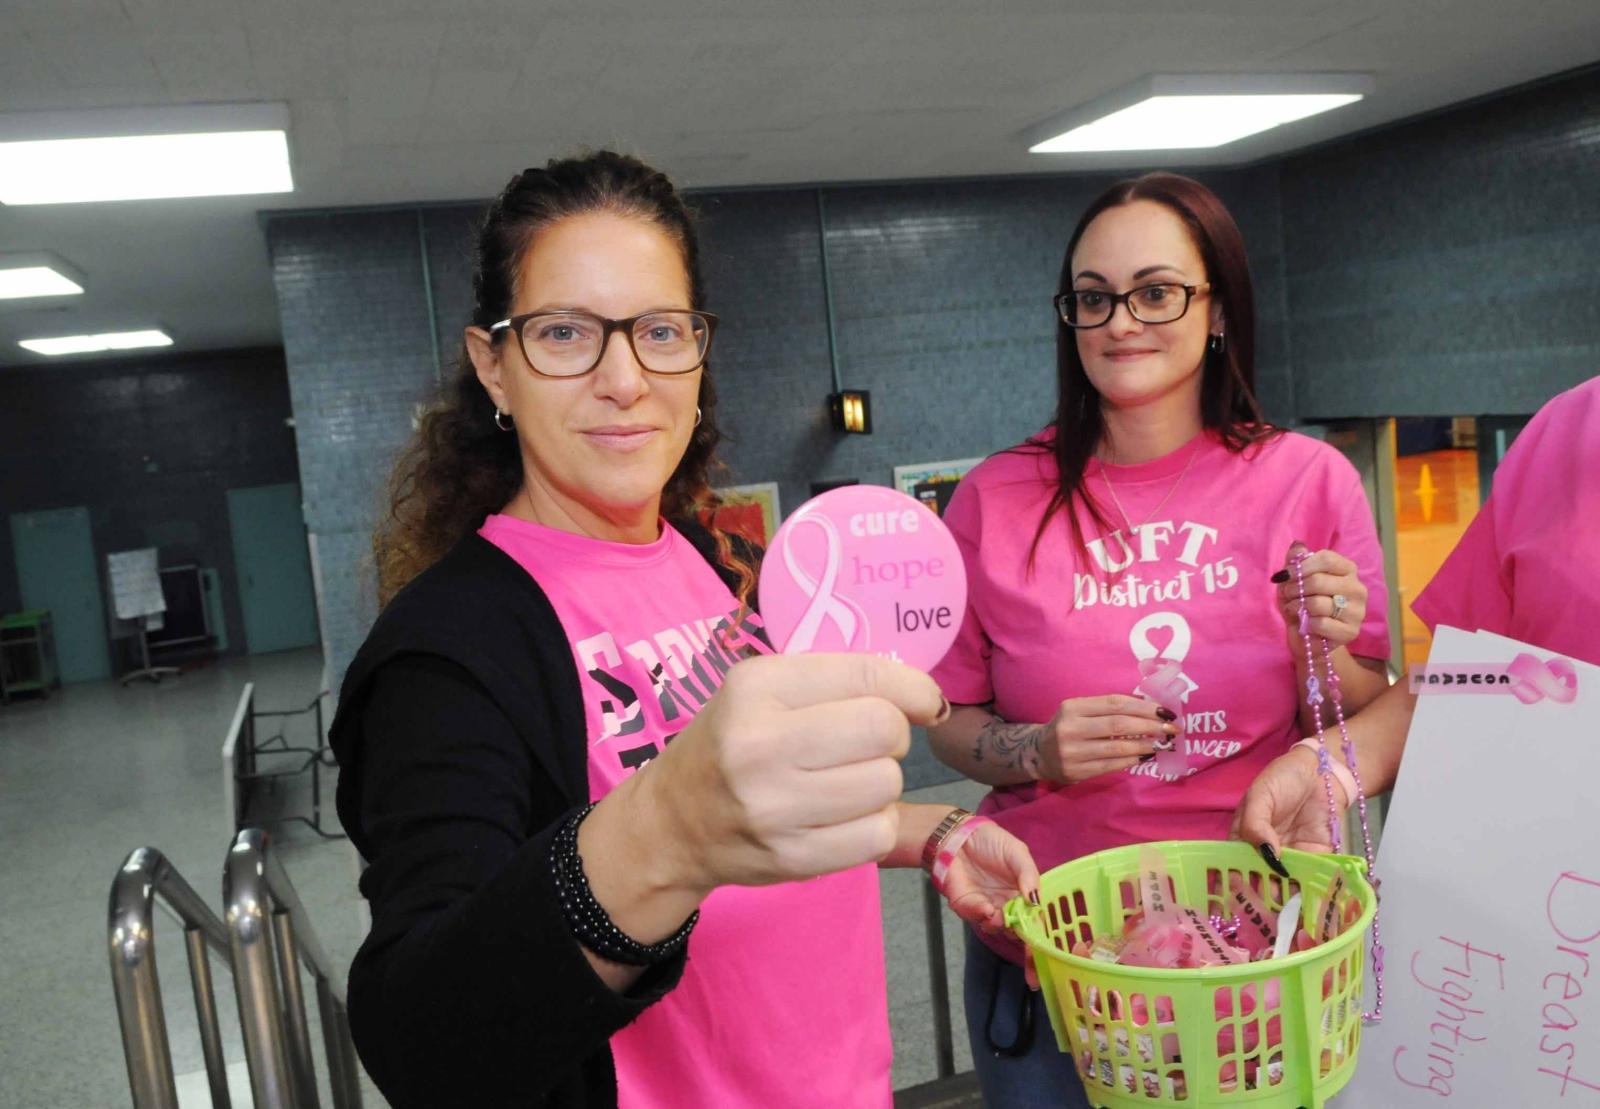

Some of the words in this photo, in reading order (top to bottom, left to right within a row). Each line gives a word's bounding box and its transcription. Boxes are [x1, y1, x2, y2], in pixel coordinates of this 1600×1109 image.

[850, 509, 919, 537] cure
[1085, 520, 1218, 573] UFT
[852, 555, 945, 590] hope
[1073, 570, 1194, 610] District
[1200, 557, 1239, 593] 15
[895, 602, 952, 633] love
[1414, 673, 1511, 685] COURAGE
[1182, 710, 1228, 735] RTS
[1392, 935, 1506, 1098] Fighting
